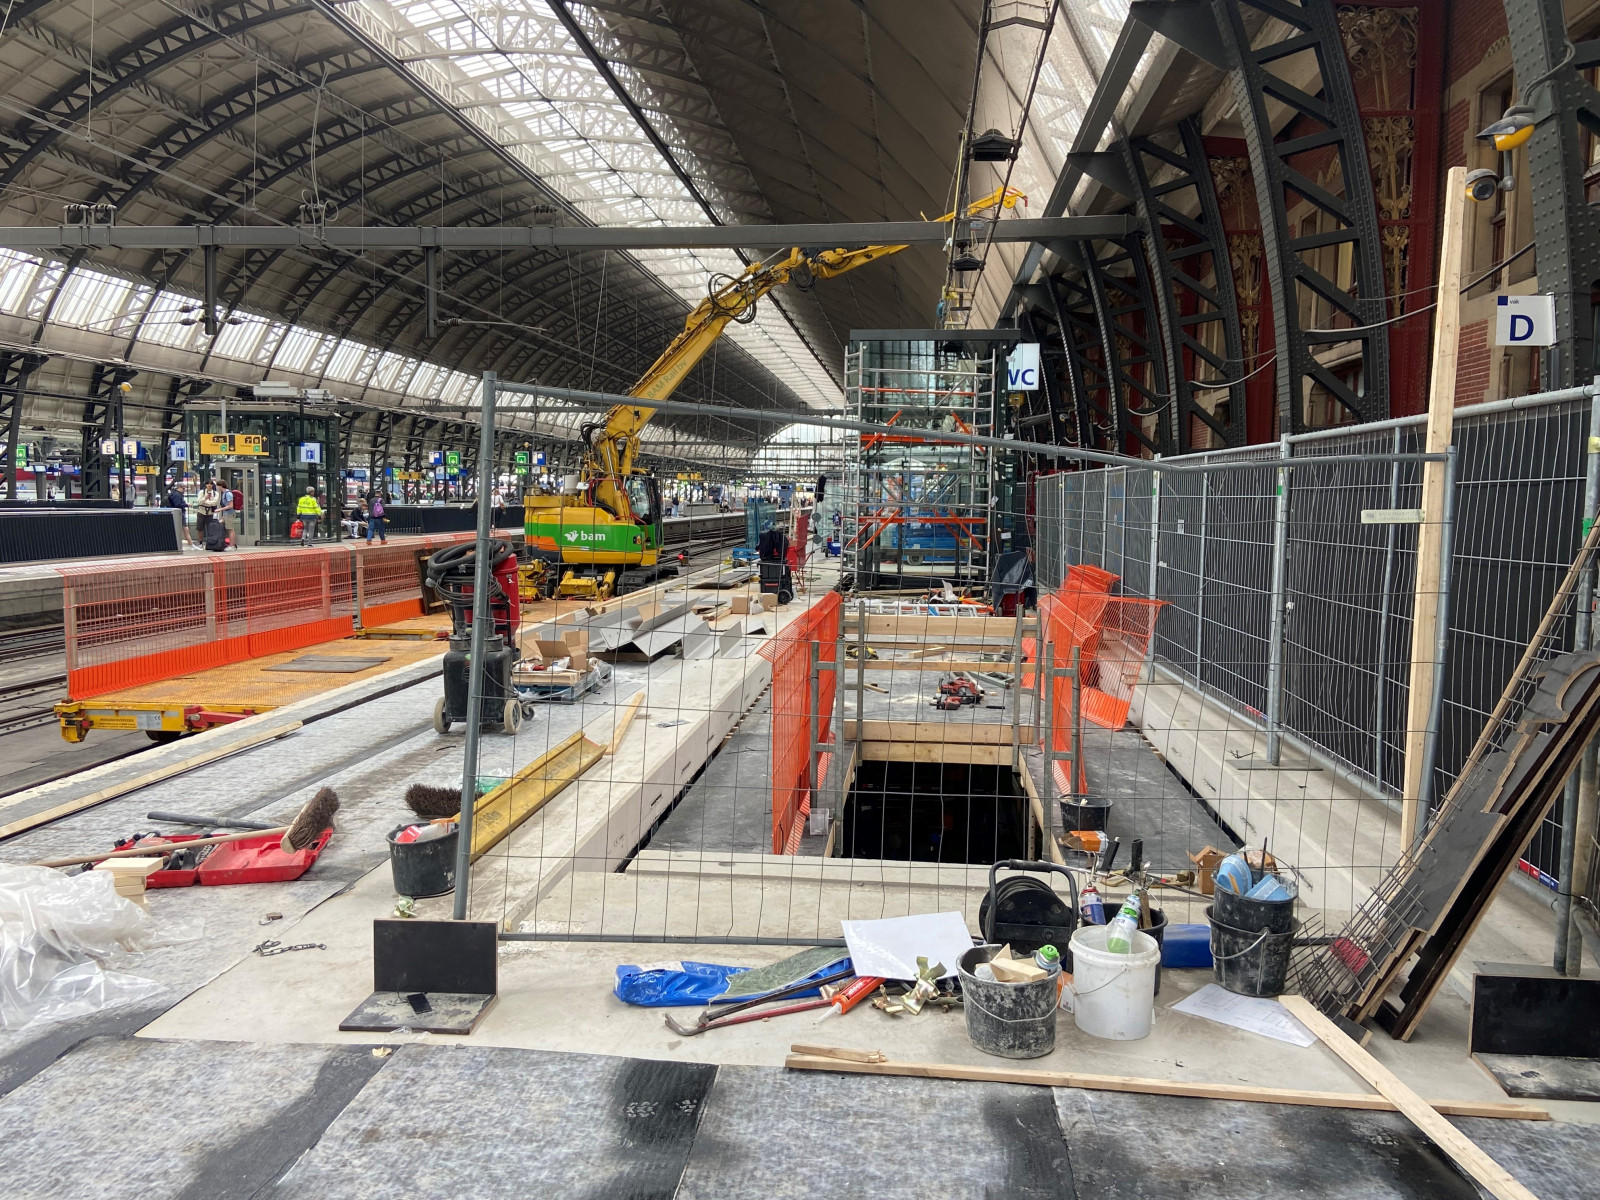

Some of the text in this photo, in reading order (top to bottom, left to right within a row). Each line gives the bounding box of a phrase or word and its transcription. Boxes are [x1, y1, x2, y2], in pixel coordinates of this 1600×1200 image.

[1510, 314, 1534, 341] D
[646, 360, 687, 399] BAM Rail bv
[106, 445, 111, 453] E
[127, 445, 132, 453] E
[580, 530, 606, 541] bam
